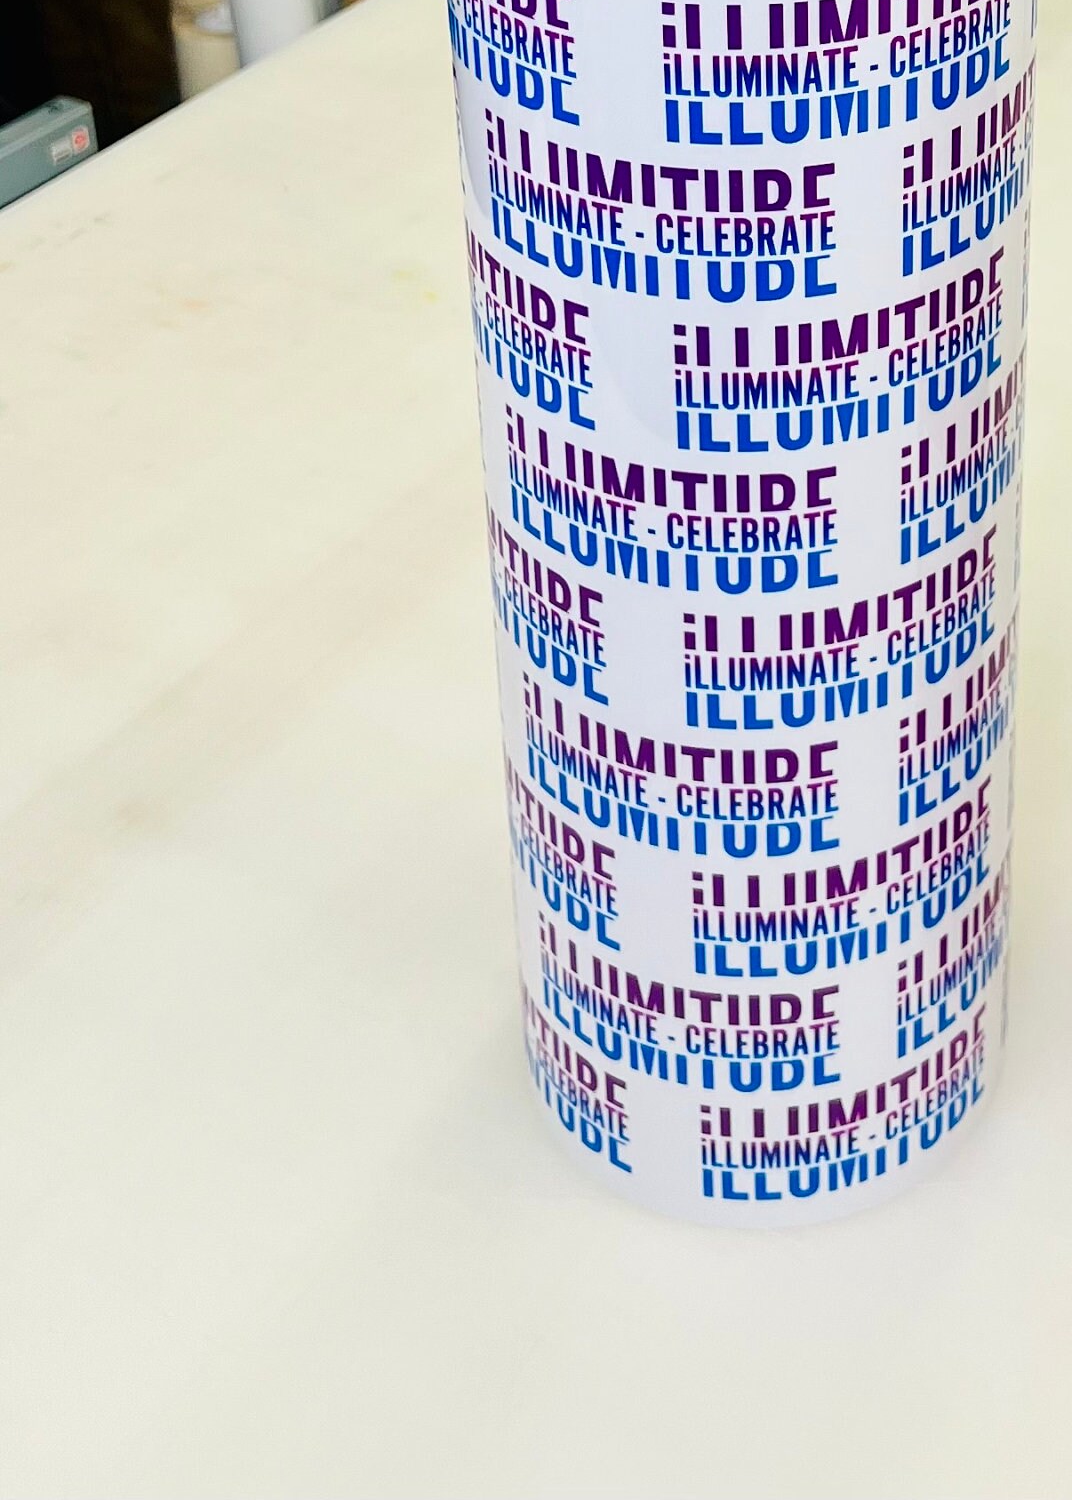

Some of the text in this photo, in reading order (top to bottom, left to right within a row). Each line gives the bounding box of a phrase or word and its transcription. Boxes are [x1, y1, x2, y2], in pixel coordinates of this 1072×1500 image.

[656, 212, 836, 259] CELEBRATE
[486, 291, 593, 388] CELEBRATE
[888, 290, 1003, 385] CELEBRATE
[667, 509, 838, 553] CELEBRATE
[886, 562, 996, 666] CELEBRATE
[677, 779, 839, 821] CELEBRATE
[886, 817, 990, 916] CELEBRATE
[686, 1019, 841, 1059] CELEBRATE
[885, 1039, 985, 1141] CELEBRATE
